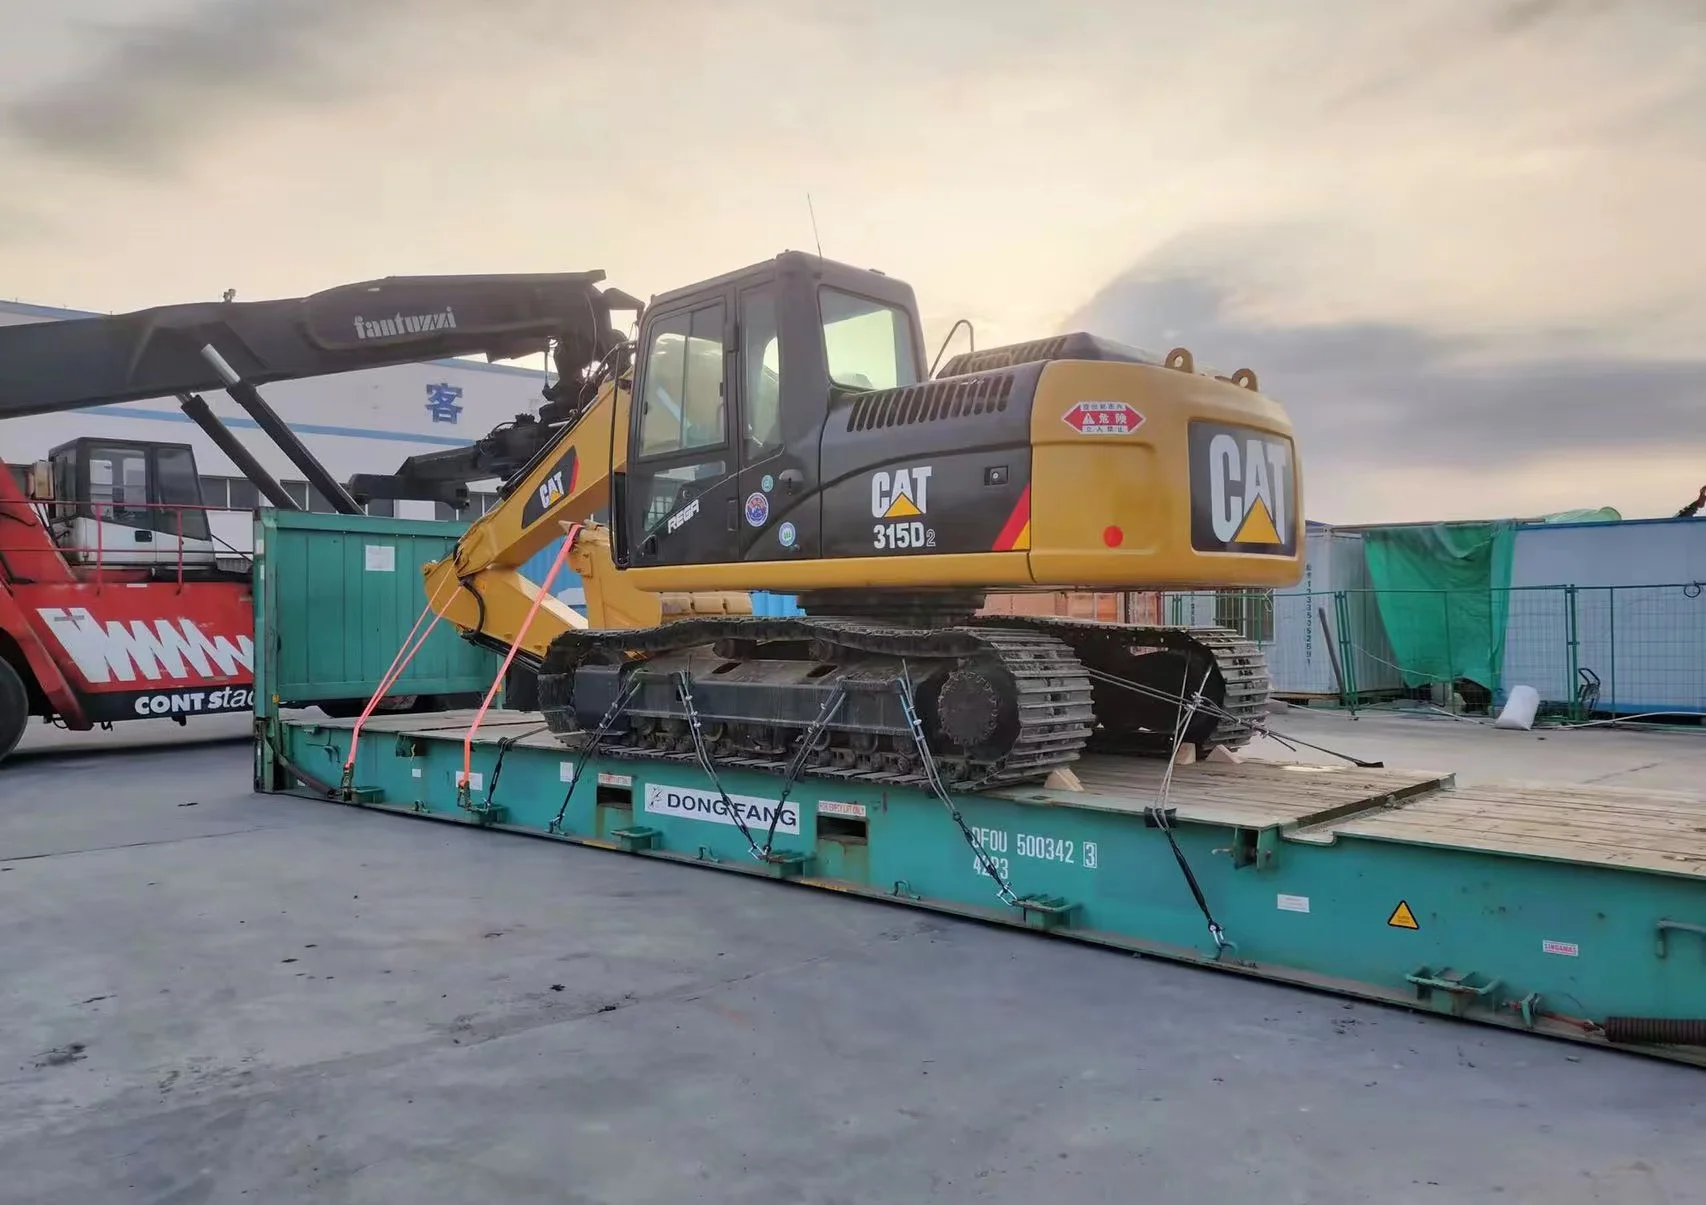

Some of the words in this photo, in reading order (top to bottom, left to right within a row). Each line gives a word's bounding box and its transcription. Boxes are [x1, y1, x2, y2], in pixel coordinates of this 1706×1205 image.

[354, 306, 457, 339] fantuzzi
[425, 383, 463, 424] 客
[540, 471, 564, 508] CAT
[872, 466, 932, 518] CAT
[1209, 434, 1286, 545] CAT
[668, 499, 700, 534] REGA
[134, 692, 205, 714] CONT
[1016, 833, 1074, 864] 500342
[1084, 843, 1096, 867] 3
